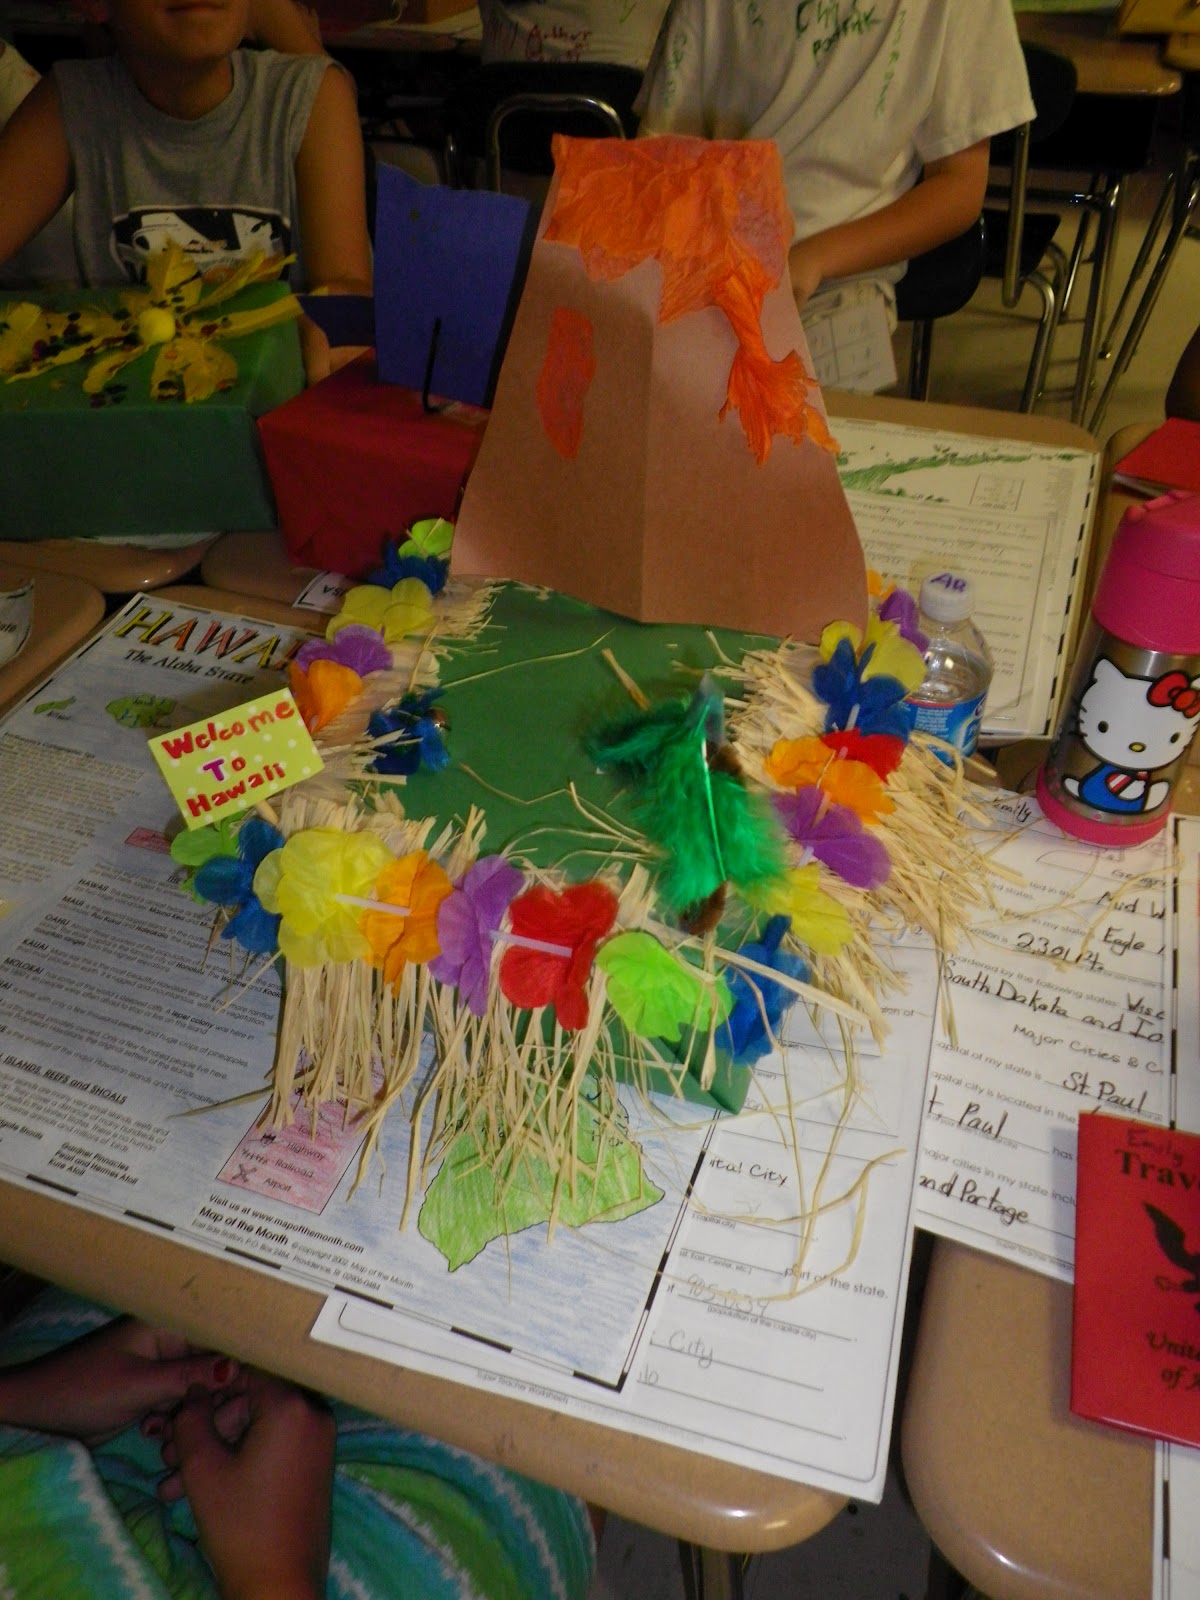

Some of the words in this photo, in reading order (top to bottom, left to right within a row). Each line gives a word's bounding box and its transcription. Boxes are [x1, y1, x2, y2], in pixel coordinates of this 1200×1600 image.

[114, 605, 305, 672] HAWAI
[124, 648, 153, 663] The
[153, 656, 203, 674] Aloha
[161, 701, 295, 759] Welcome
[202, 756, 246, 781] To
[186, 763, 286, 818] Hawaii
[62, 895, 84, 906] MAUI
[79, 878, 108, 891] HAWAII
[150, 906, 171, 916] Mauna
[1102, 925, 1146, 956] Eagle
[22, 938, 49, 952] KAUAI
[230, 1003, 248, 1011] more
[1000, 966, 1015, 979] by
[1017, 970, 1034, 985] the
[1036, 976, 1083, 1001] following
[5, 956, 44, 974] MOLOKAI
[171, 1010, 190, 1020] leper
[191, 1015, 214, 1028] colony
[230, 1028, 247, 1037] here
[943, 959, 990, 994] South
[996, 979, 1069, 1018] Dakota
[1081, 1012, 1124, 1032] and
[118, 1021, 143, 1034] people
[158, 1033, 178, 1045] huge
[178, 1040, 199, 1051] crops
[208, 1049, 249, 1068] pineapples.
[1012, 1023, 1064, 1046] Major
[1069, 1040, 1121, 1064] Cities
[1127, 1056, 1139, 1069] &
[4, 1055, 43, 1074] ISLANDS,
[44, 1069, 70, 1084] REEFS
[90, 1085, 127, 1104] SHOALS
[94, 1058, 129, 1074] Hawaiian
[128, 1070, 153, 1082] islands
[140, 1045, 170, 1060] hundred
[170, 1056, 197, 1070] people
[197, 1065, 210, 1073] live
[210, 1069, 229, 1080] here.
[971, 1050, 983, 1061] of
[985, 1055, 1002, 1069] my
[1003, 1061, 1033, 1077] state
[1035, 1069, 1043, 1079] is
[930, 1070, 963, 1086] apital
[964, 1081, 984, 1096] city
[986, 1087, 995, 1098] is
[996, 1089, 1043, 1114] located
[1044, 1105, 1055, 1117] in
[1056, 1109, 1078, 1124] the
[1096, 1080, 1149, 1114] Paul
[957, 1101, 1009, 1140] Paul
[49, 1157, 67, 1168] Kure
[68, 1165, 86, 1175] Atoll
[286, 1141, 327, 1161] Highway
[1052, 1146, 1074, 1161] has
[120, 1173, 139, 1184] Atoll
[263, 1177, 292, 1193] Airport
[275, 1159, 315, 1179] Railroad
[749, 1163, 788, 1187] City
[952, 1157, 982, 1175] cities
[984, 1166, 995, 1179] in
[997, 1173, 1017, 1187] my
[1019, 1179, 1049, 1197] state
[1113, 1148, 1200, 1192] Trav
[960, 1178, 1029, 1227] Portage
[210, 1194, 229, 1206] Visit
[252, 1209, 365, 1253] www.mapofthemonth.com
[696, 1214, 721, 1227] capital
[256, 1226, 290, 1244] Month
[391, 1275, 415, 1289] Month
[830, 1276, 850, 1290] the
[750, 1316, 758, 1325] of
[759, 1317, 773, 1328] the
[668, 1327, 713, 1369] City
